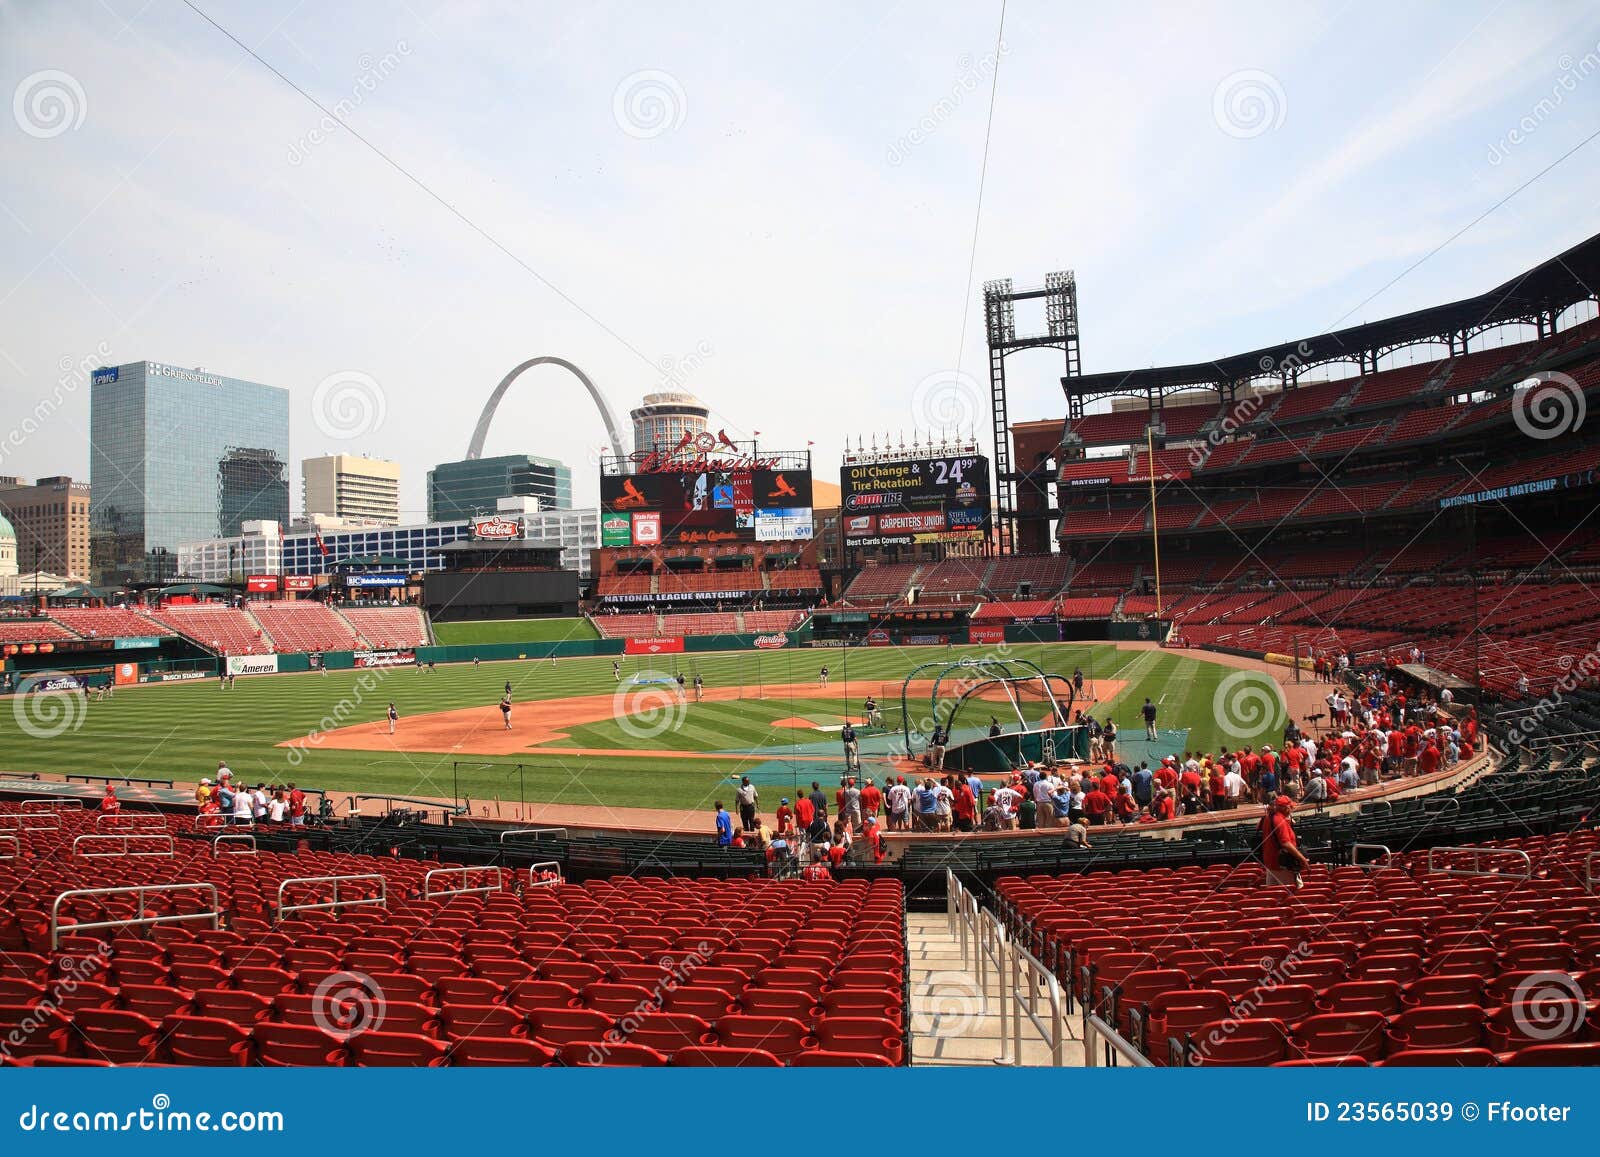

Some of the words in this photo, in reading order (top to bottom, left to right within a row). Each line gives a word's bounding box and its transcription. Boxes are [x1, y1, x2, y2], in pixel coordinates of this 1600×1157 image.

[629, 451, 782, 473] Budweiser
[851, 467, 866, 479] Oil
[868, 465, 909, 478] Change
[911, 464, 920, 474] &
[851, 480, 872, 491] Tire
[873, 477, 922, 490] Rotation!
[1071, 478, 1111, 486] MATCHUP
[1439, 495, 1477, 508] NATIONAL
[1477, 488, 1508, 502] LEAGUE
[1509, 478, 1557, 497] MATCHUP
[758, 527, 793, 538] Anthem
[846, 538, 861, 547] Best
[862, 537, 880, 545] Cards
[881, 536, 912, 546] Coverage
[604, 594, 652, 602] NATIONAL
[656, 592, 694, 601] LEAGUE
[695, 590, 746, 599] MATCHUP
[241, 663, 274, 674] Ameren
